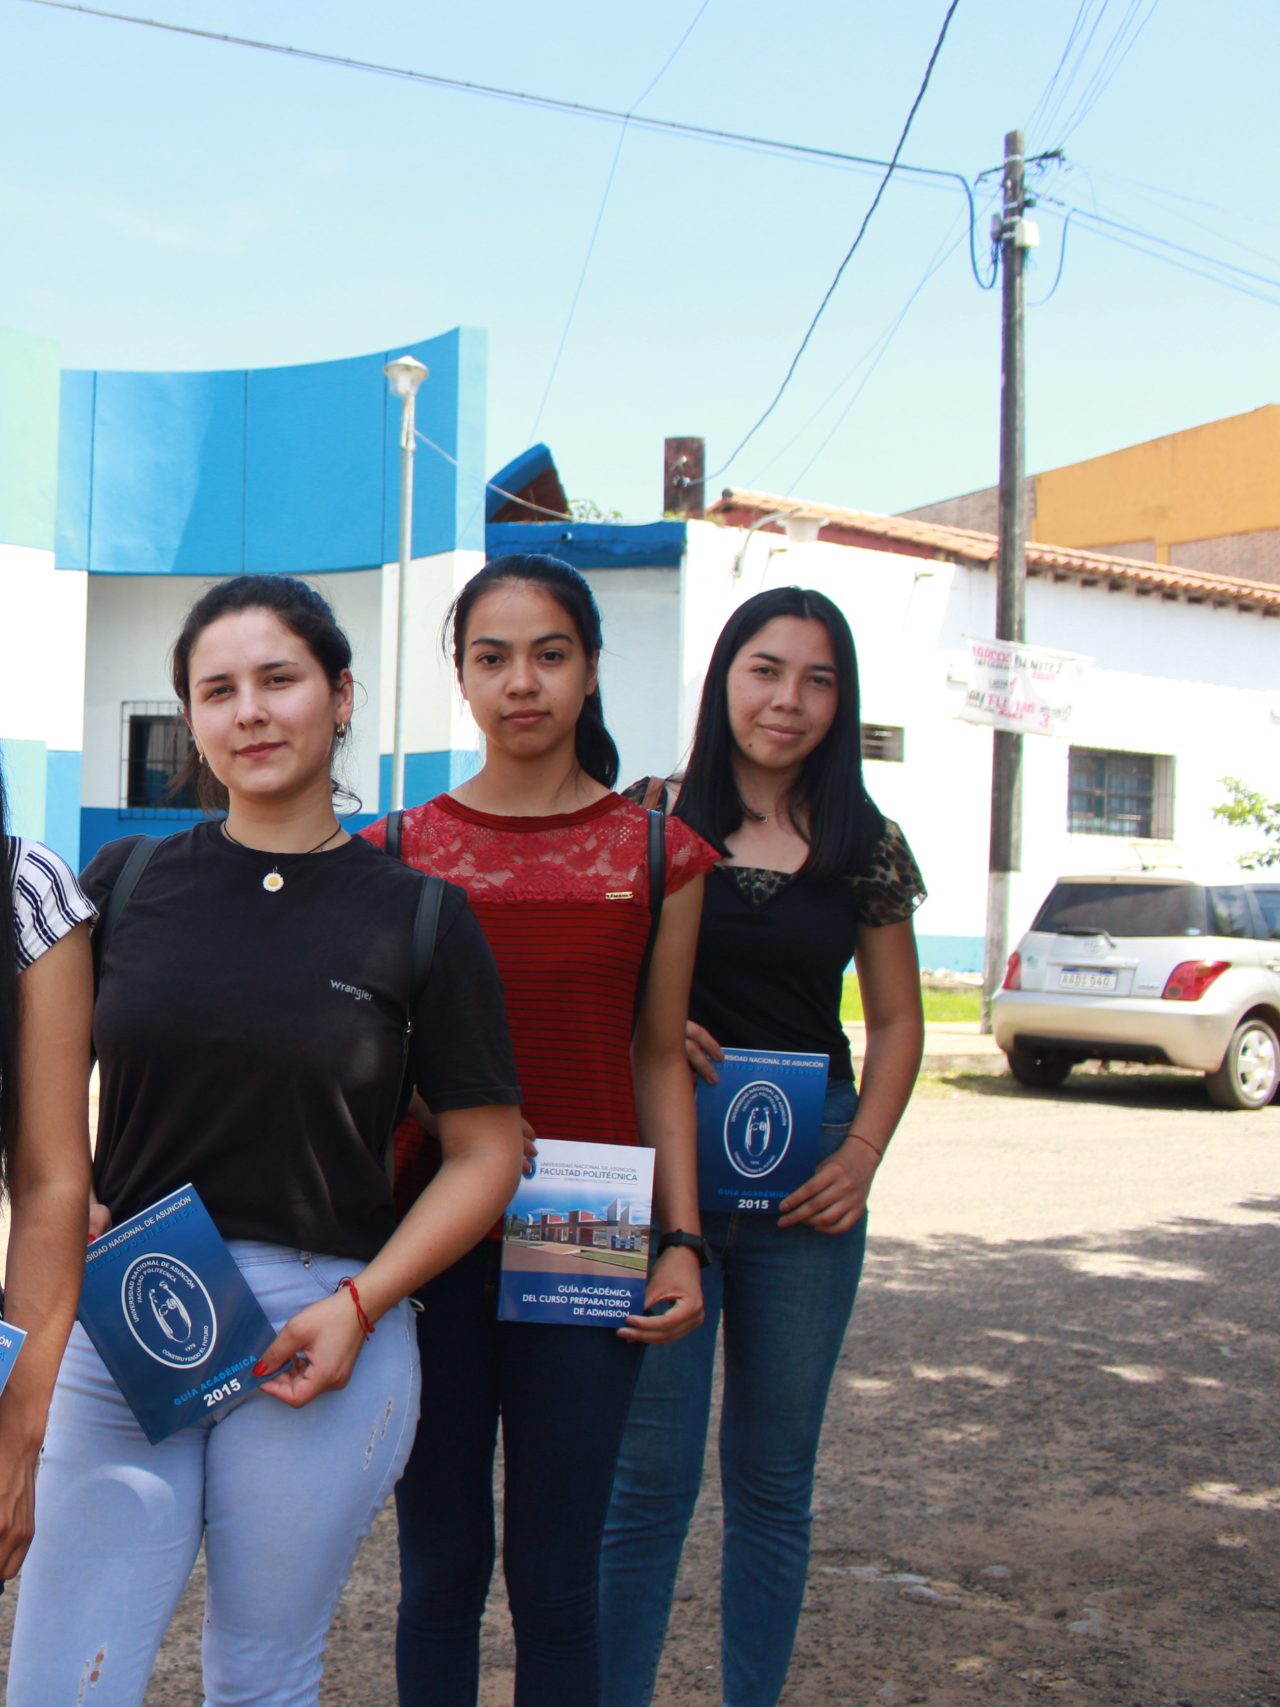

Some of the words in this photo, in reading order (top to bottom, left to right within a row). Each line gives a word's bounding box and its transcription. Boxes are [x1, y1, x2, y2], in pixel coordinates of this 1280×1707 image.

[749, 1056, 780, 1066] NACIONAL
[540, 1167, 581, 1177] FACULTAD
[583, 1169, 638, 1181] POLITÉCNICA
[737, 1198, 769, 1210] 2015
[85, 1245, 109, 1264] SIDAD
[108, 1225, 145, 1249] NACIONAL
[144, 1216, 156, 1228] DE
[155, 1195, 192, 1222] ASUNCIÓN
[131, 1260, 160, 1280] NACIONAL
[161, 1260, 171, 1269] DE
[558, 1284, 579, 1294] GUÍA
[581, 1286, 631, 1298] ACADÉMICA
[127, 1280, 140, 1323] UNIVERSIDAD
[522, 1294, 537, 1303] DEL
[539, 1295, 568, 1304] CURSO
[570, 1296, 631, 1309] PREPARATORIO
[573, 1308, 585, 1316] DE
[586, 1308, 630, 1319] ADMISIÓN
[173, 1388, 198, 1406] GUÍA
[200, 1355, 258, 1391] ACADÉMICA
[203, 1378, 241, 1407] 2015
